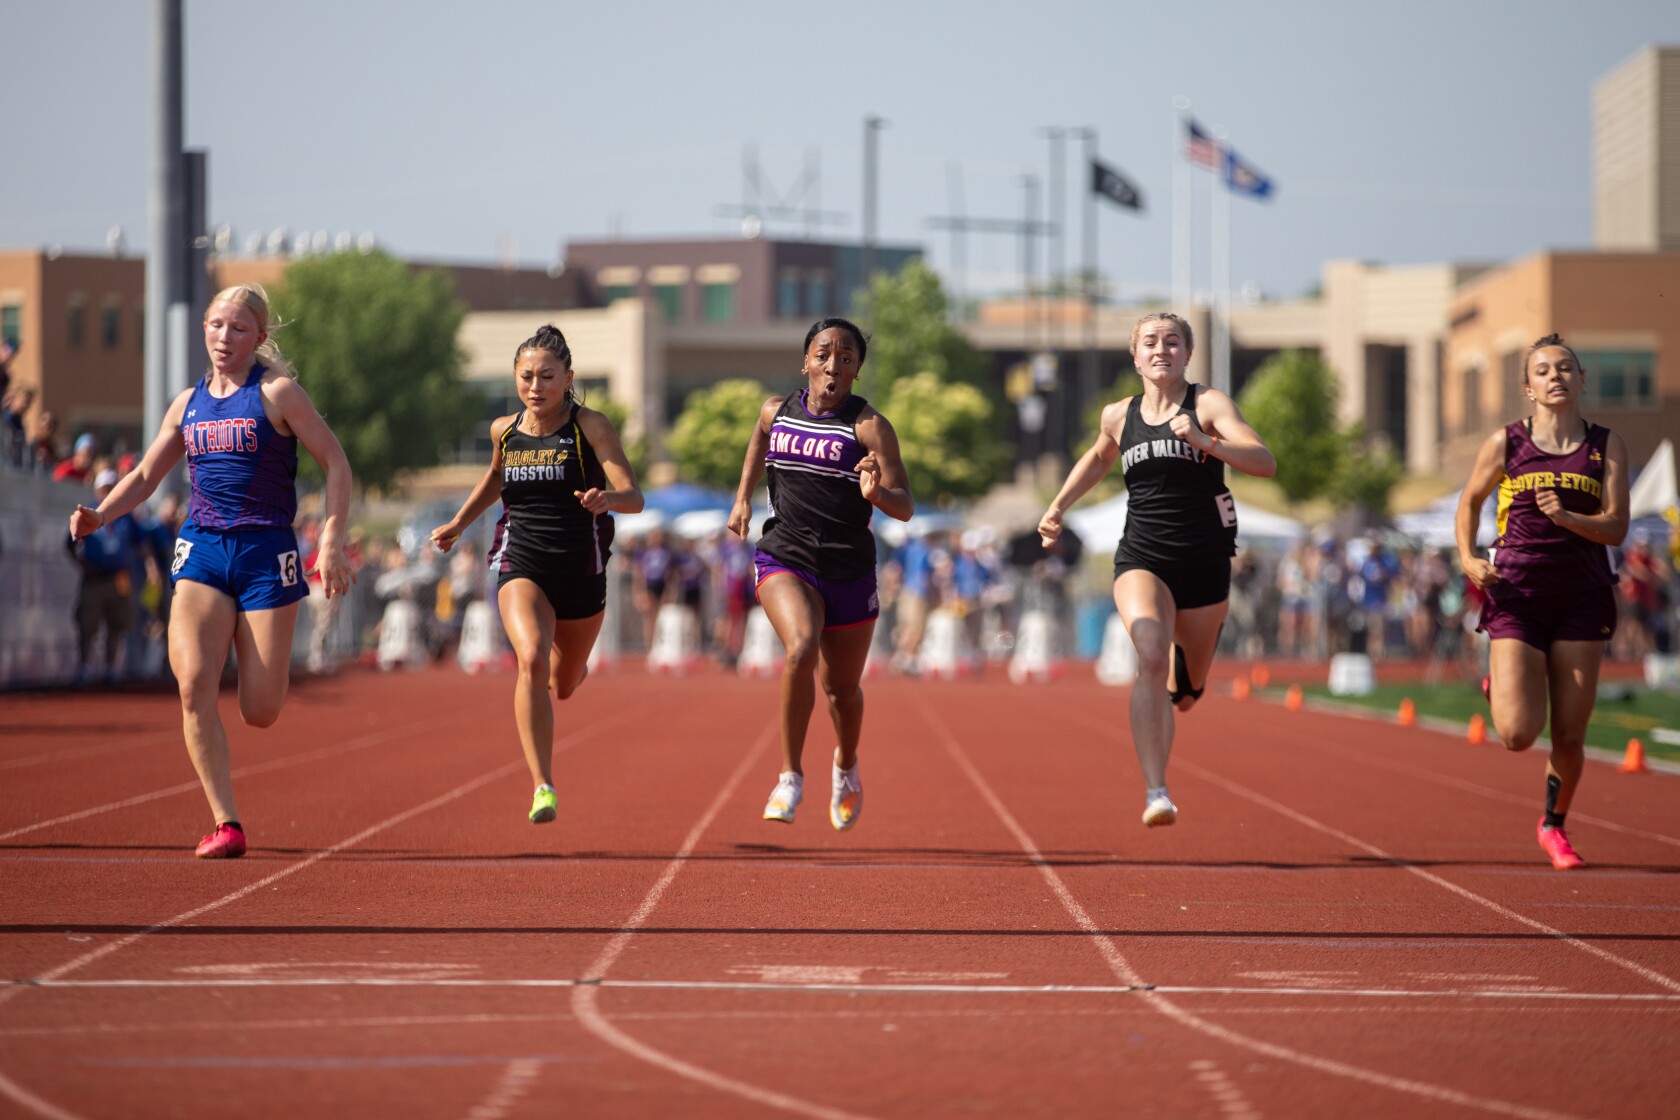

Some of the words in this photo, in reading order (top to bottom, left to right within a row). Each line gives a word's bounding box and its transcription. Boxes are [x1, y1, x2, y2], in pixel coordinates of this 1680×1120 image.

[505, 449, 556, 467] BAGLEY
[770, 432, 843, 461] GMLOKS
[1151, 439, 1200, 463] VALLEY
[505, 466, 565, 483] FOSSTON
[285, 553, 297, 584] 6
